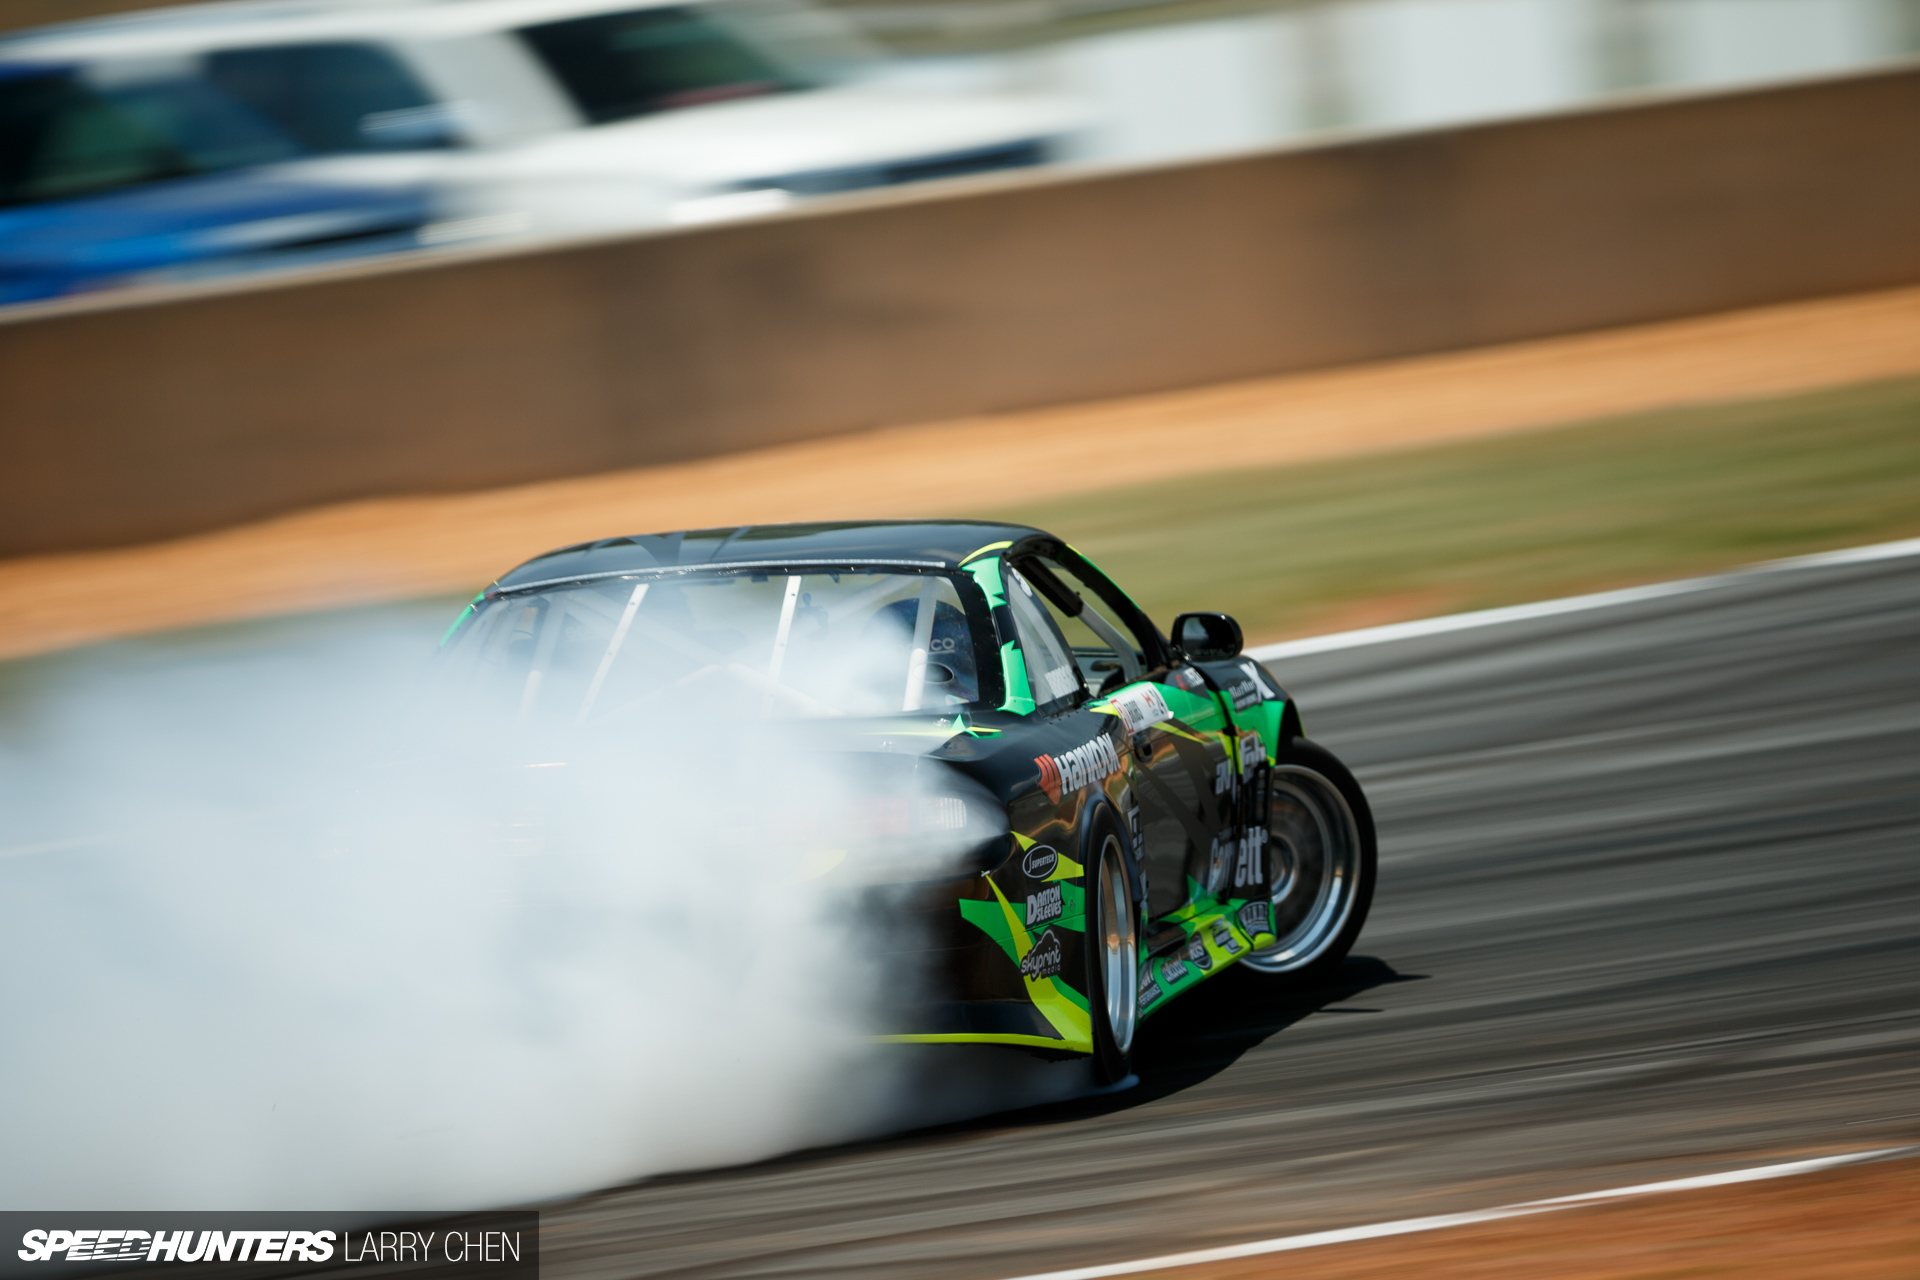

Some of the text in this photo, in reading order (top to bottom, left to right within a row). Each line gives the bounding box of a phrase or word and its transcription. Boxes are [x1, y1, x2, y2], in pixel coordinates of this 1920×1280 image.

[1031, 853, 1055, 870] SUPERTECH
[1026, 885, 1061, 926] DARTON
[1036, 901, 1062, 922] SLEEVES
[1021, 944, 1061, 979] skyprint
